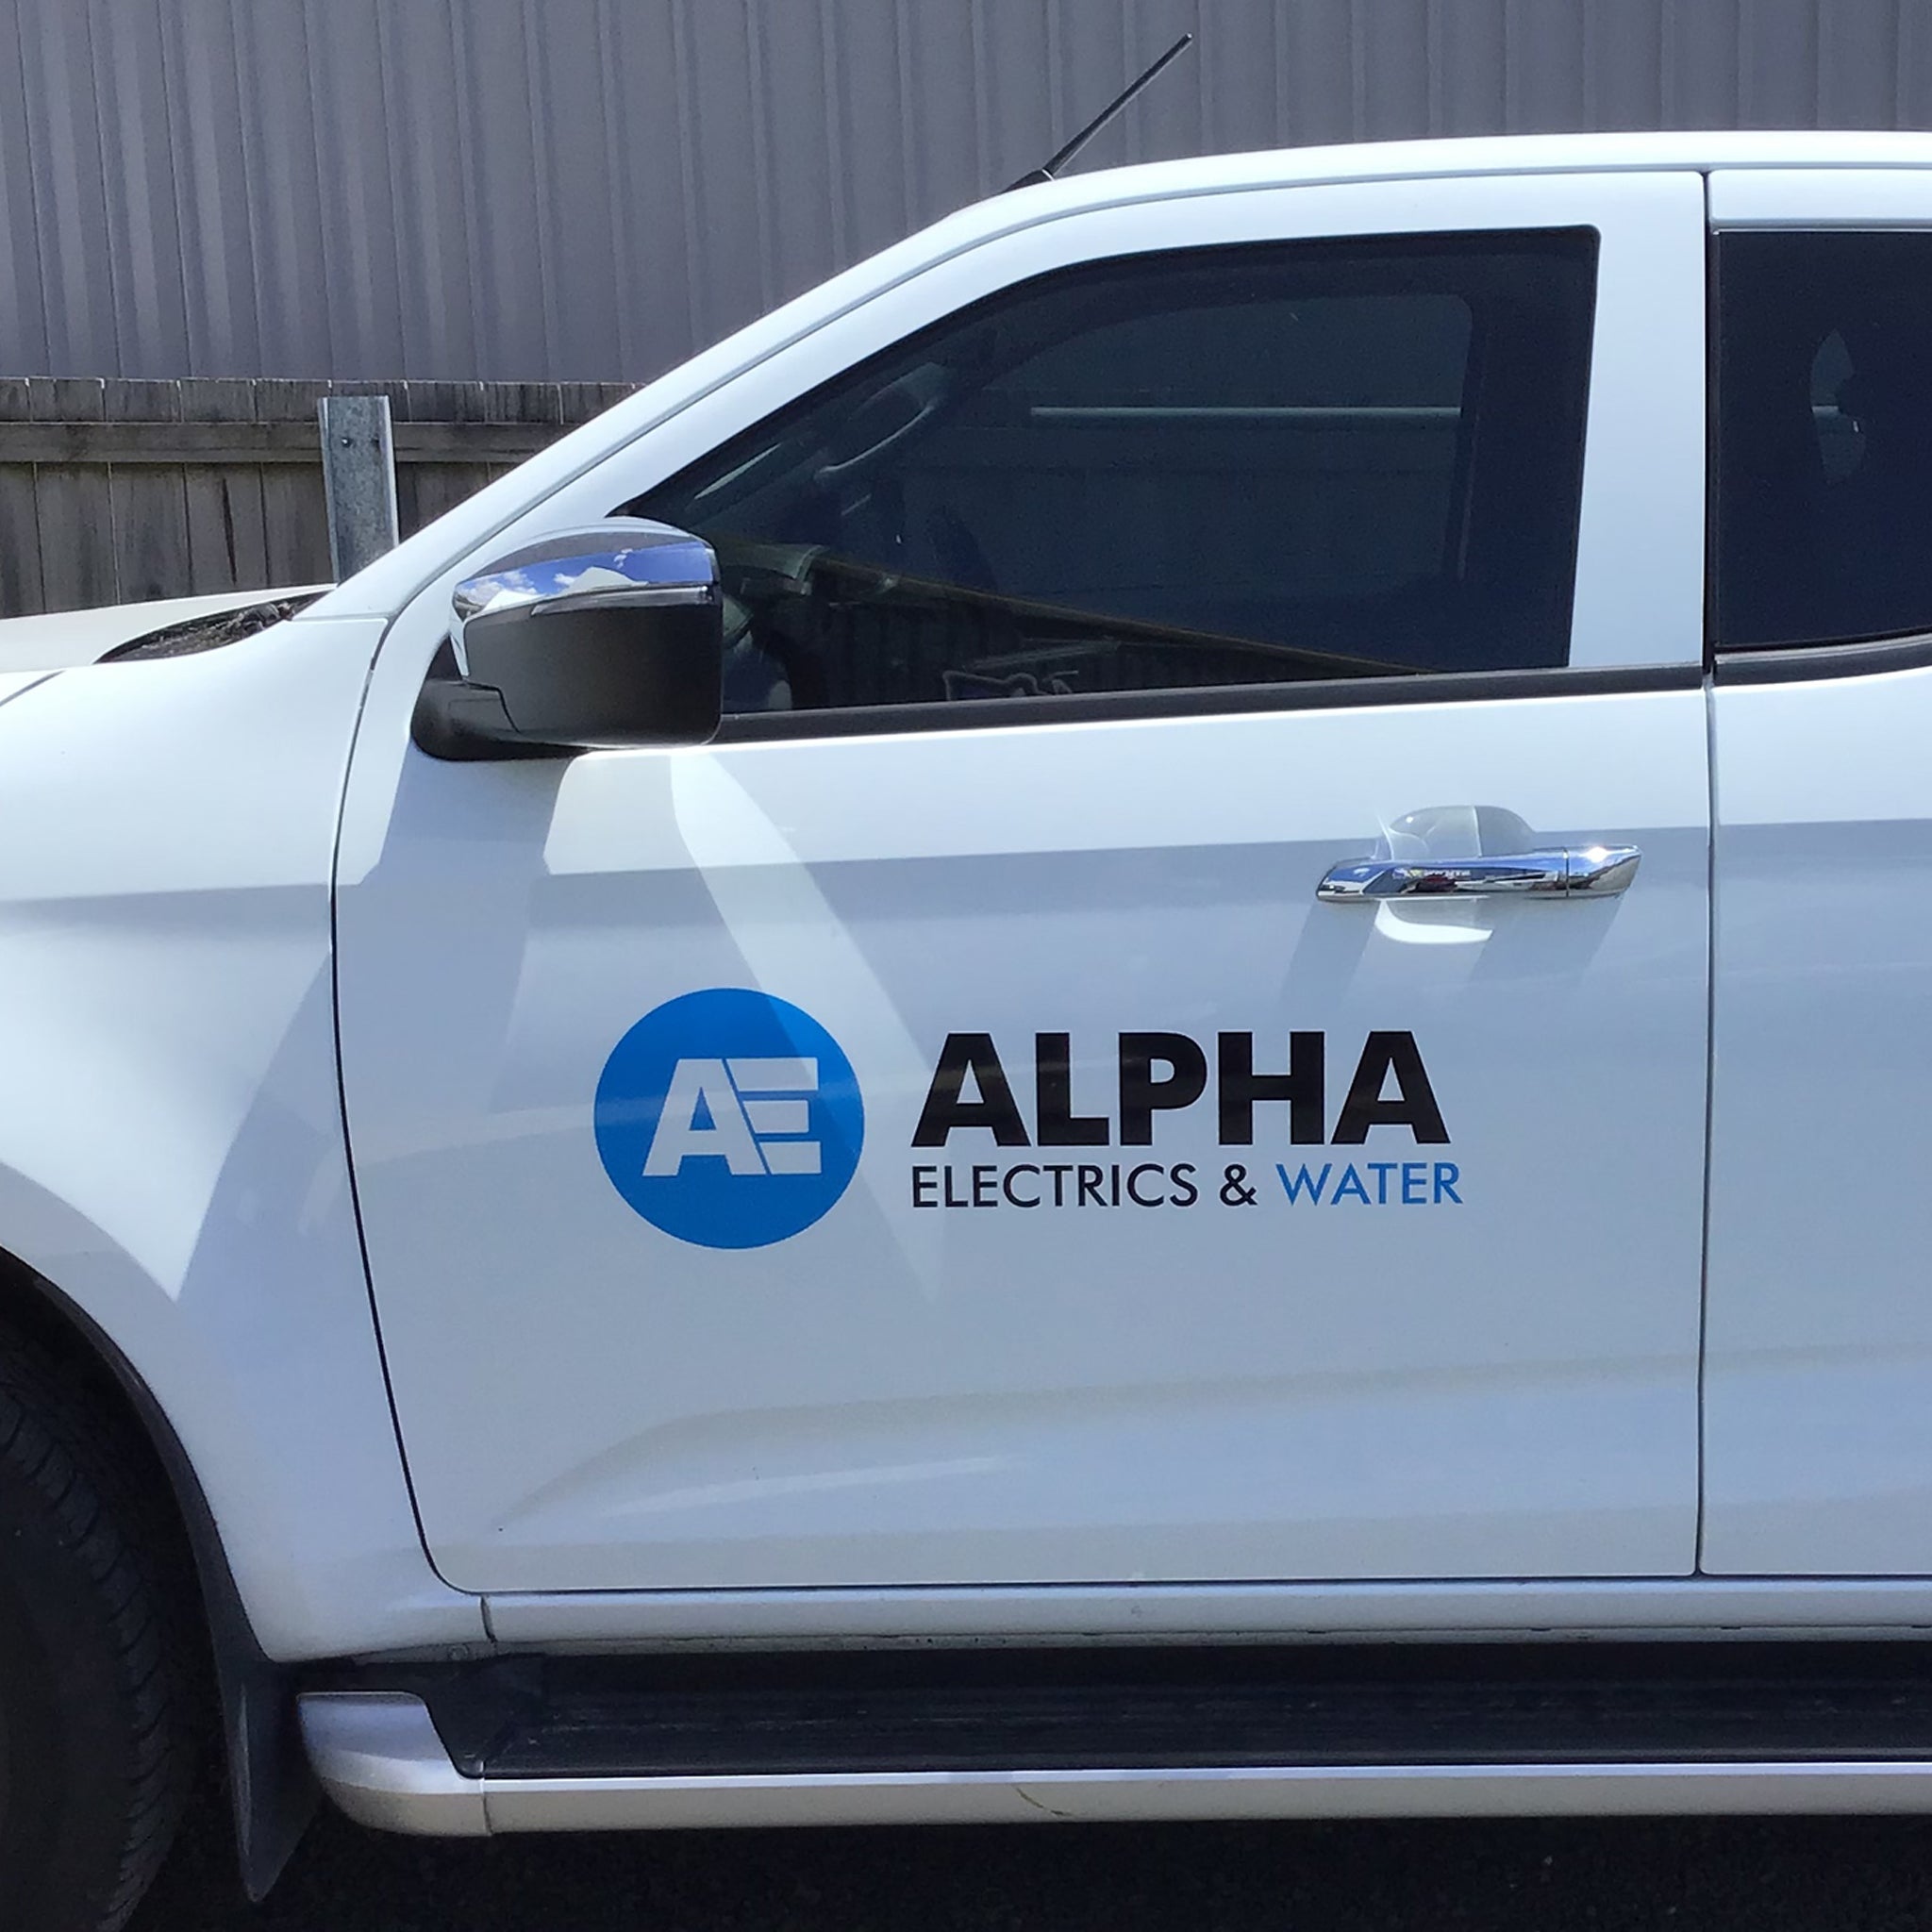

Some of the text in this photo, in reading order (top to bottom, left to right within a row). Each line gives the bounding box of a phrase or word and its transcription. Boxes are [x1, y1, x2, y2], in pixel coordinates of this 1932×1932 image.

[643, 1058, 821, 1176] AE
[911, 1031, 1452, 1148] ALPHA
[912, 1161, 1463, 1208] ELECTRICS & WATER
